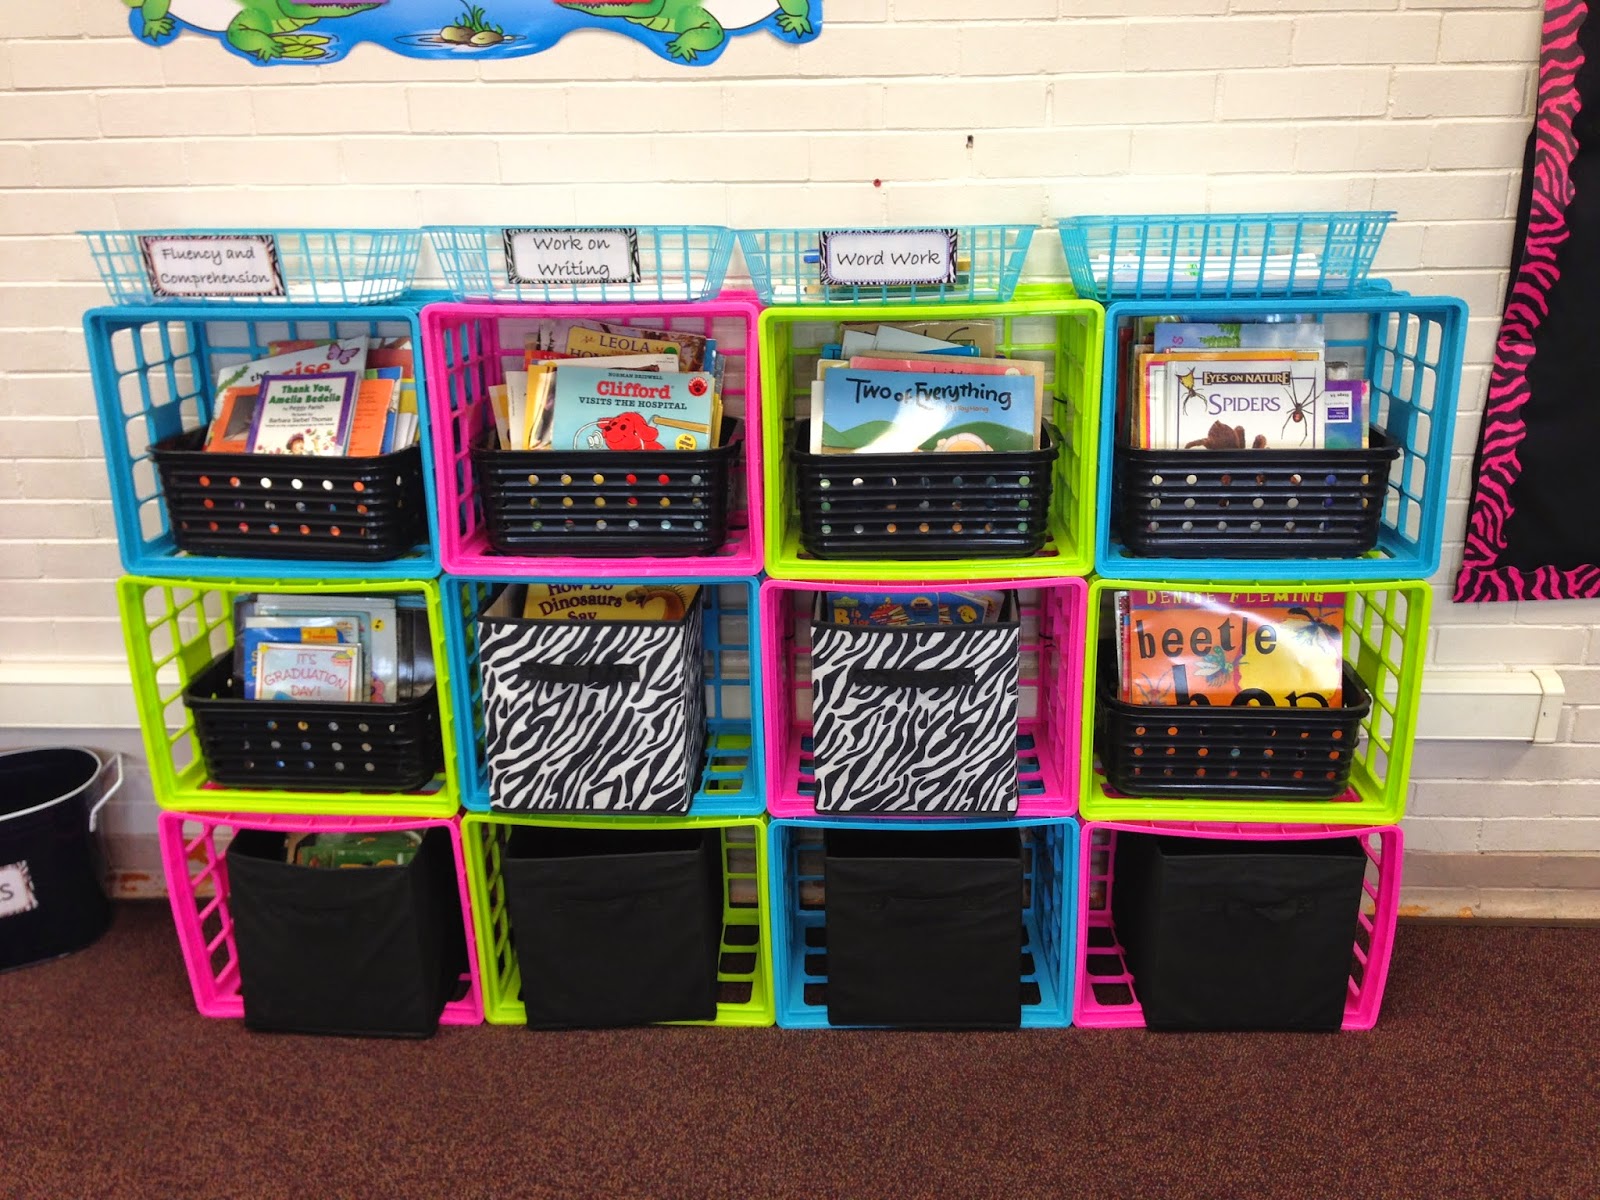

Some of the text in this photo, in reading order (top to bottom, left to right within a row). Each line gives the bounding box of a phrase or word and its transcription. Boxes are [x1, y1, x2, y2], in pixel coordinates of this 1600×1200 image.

[533, 235, 610, 250] Work on
[162, 247, 255, 265] Fluency and
[837, 250, 941, 265] Word Work
[538, 260, 610, 279] Writing
[160, 271, 270, 288] Comprehension
[600, 335, 650, 353] LEOLA
[1203, 373, 1228, 384] EYES
[1245, 373, 1290, 385] NATURE
[282, 384, 333, 394] Thank You,
[597, 380, 671, 399] Clifford
[846, 378, 1012, 411] Two of Everything
[269, 394, 341, 404] Amelia Bedelia
[579, 396, 688, 410] VISITS THE HOSPITAL
[1208, 393, 1281, 415] SPIDERS
[538, 595, 622, 616] Dinosaurs
[1229, 593, 1324, 604] FLEMING
[1136, 617, 1277, 659] beetle
[264, 668, 348, 690] GRADUATION
[290, 685, 321, 697] DAY!
